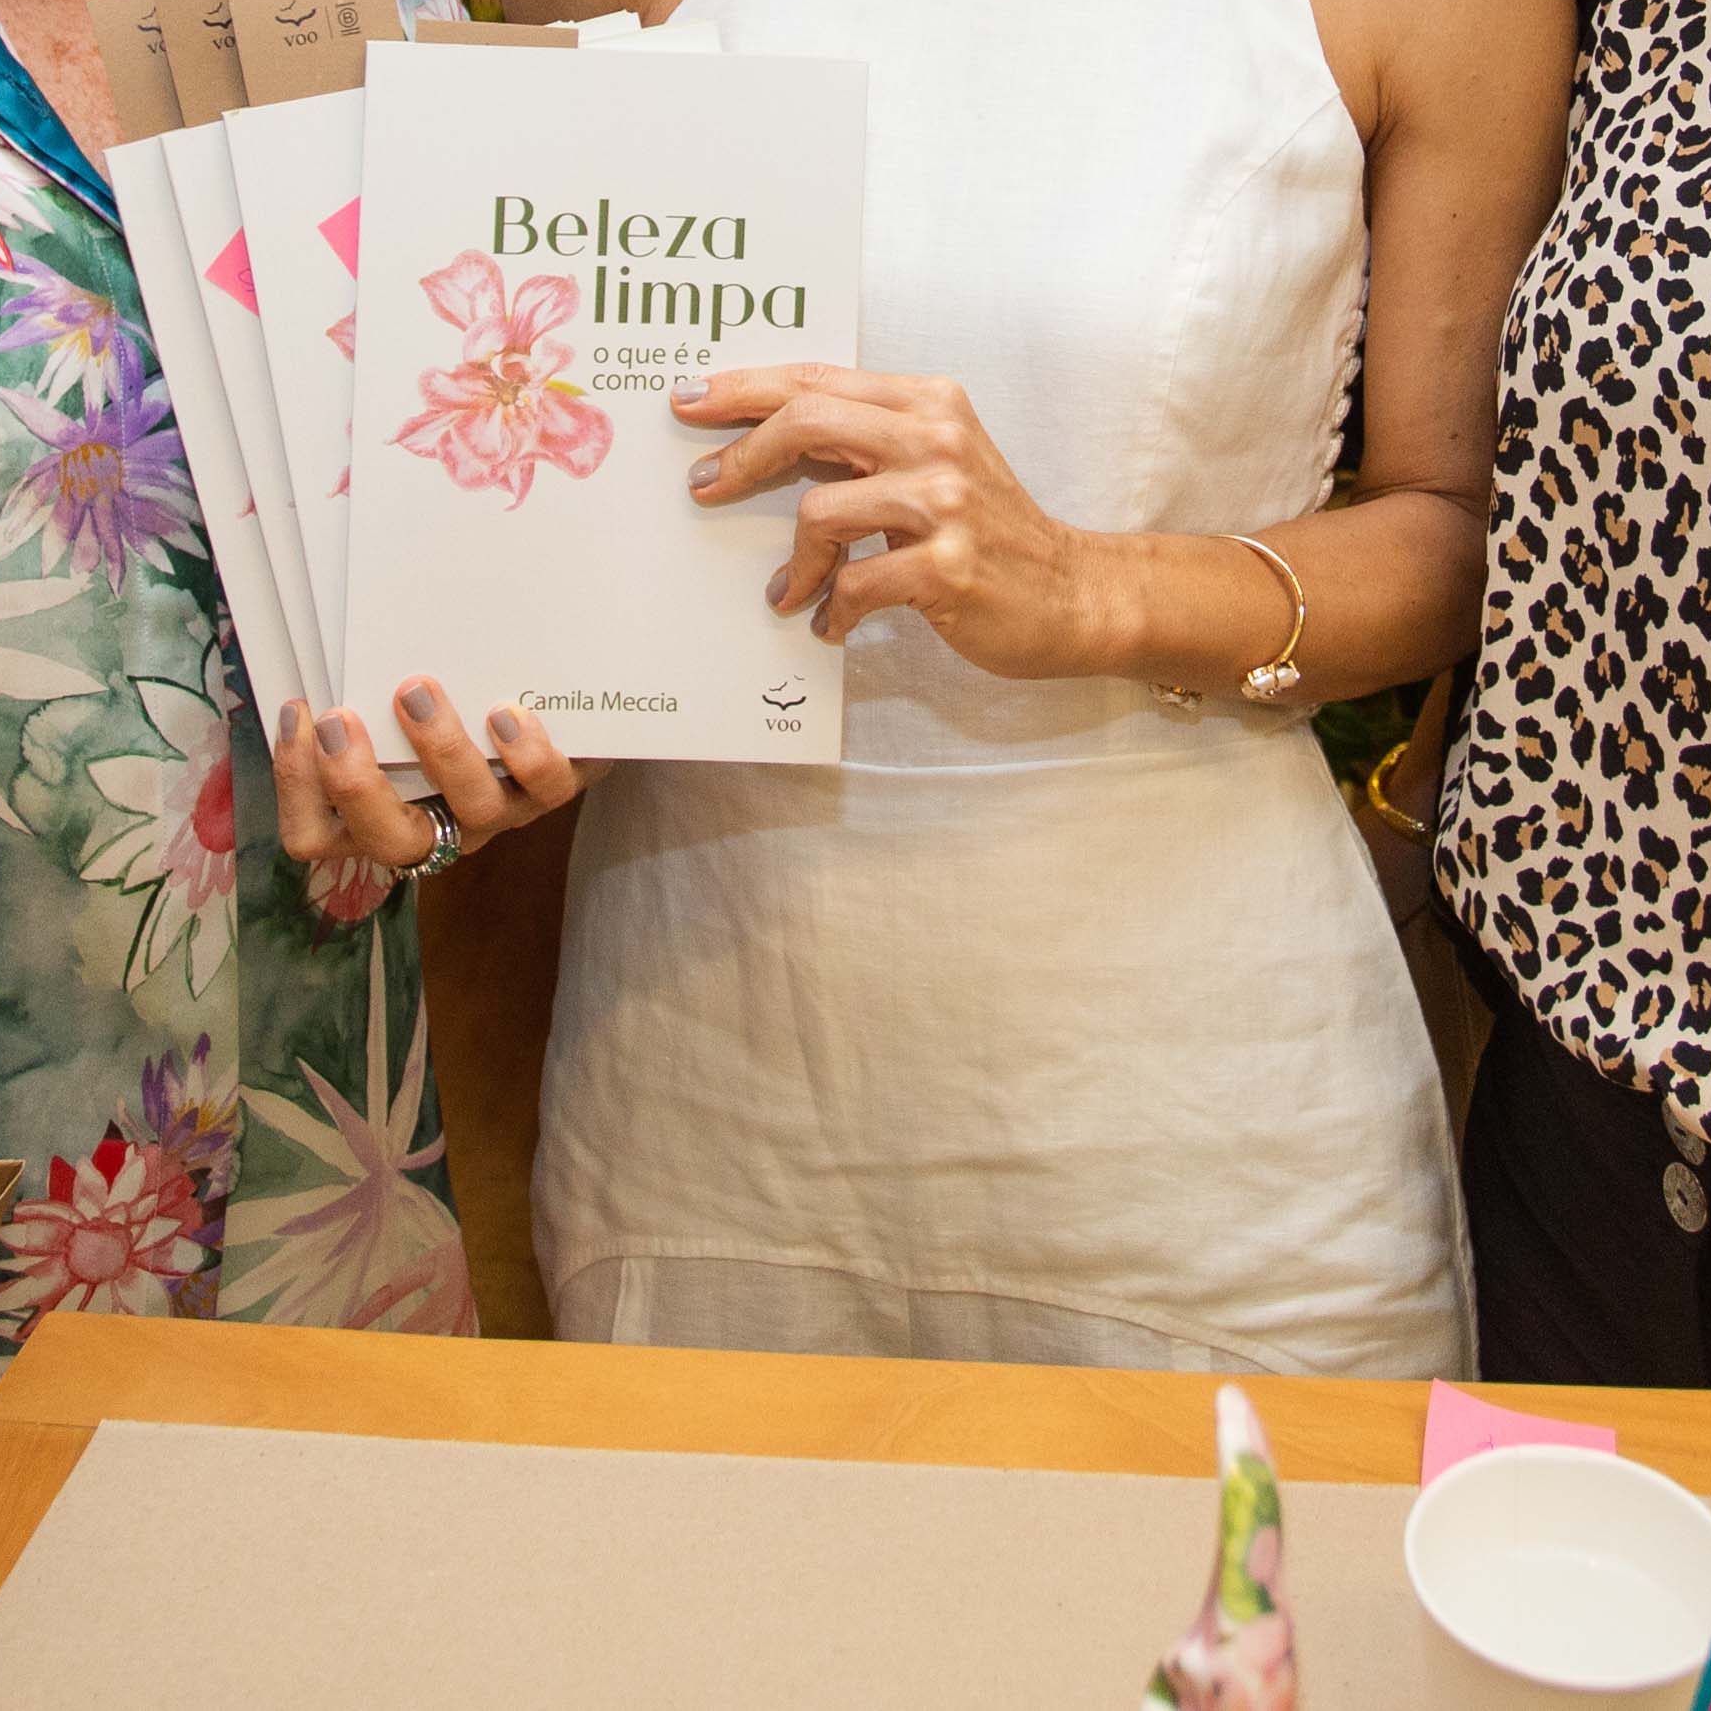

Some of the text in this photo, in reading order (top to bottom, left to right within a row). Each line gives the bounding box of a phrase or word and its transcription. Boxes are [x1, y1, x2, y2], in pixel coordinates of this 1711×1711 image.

[493, 195, 746, 260] Beleza
[593, 265, 806, 342] limpa
[593, 342, 711, 369] o que é e
[592, 373, 665, 391] como
[519, 689, 678, 712] Camila Meccia
